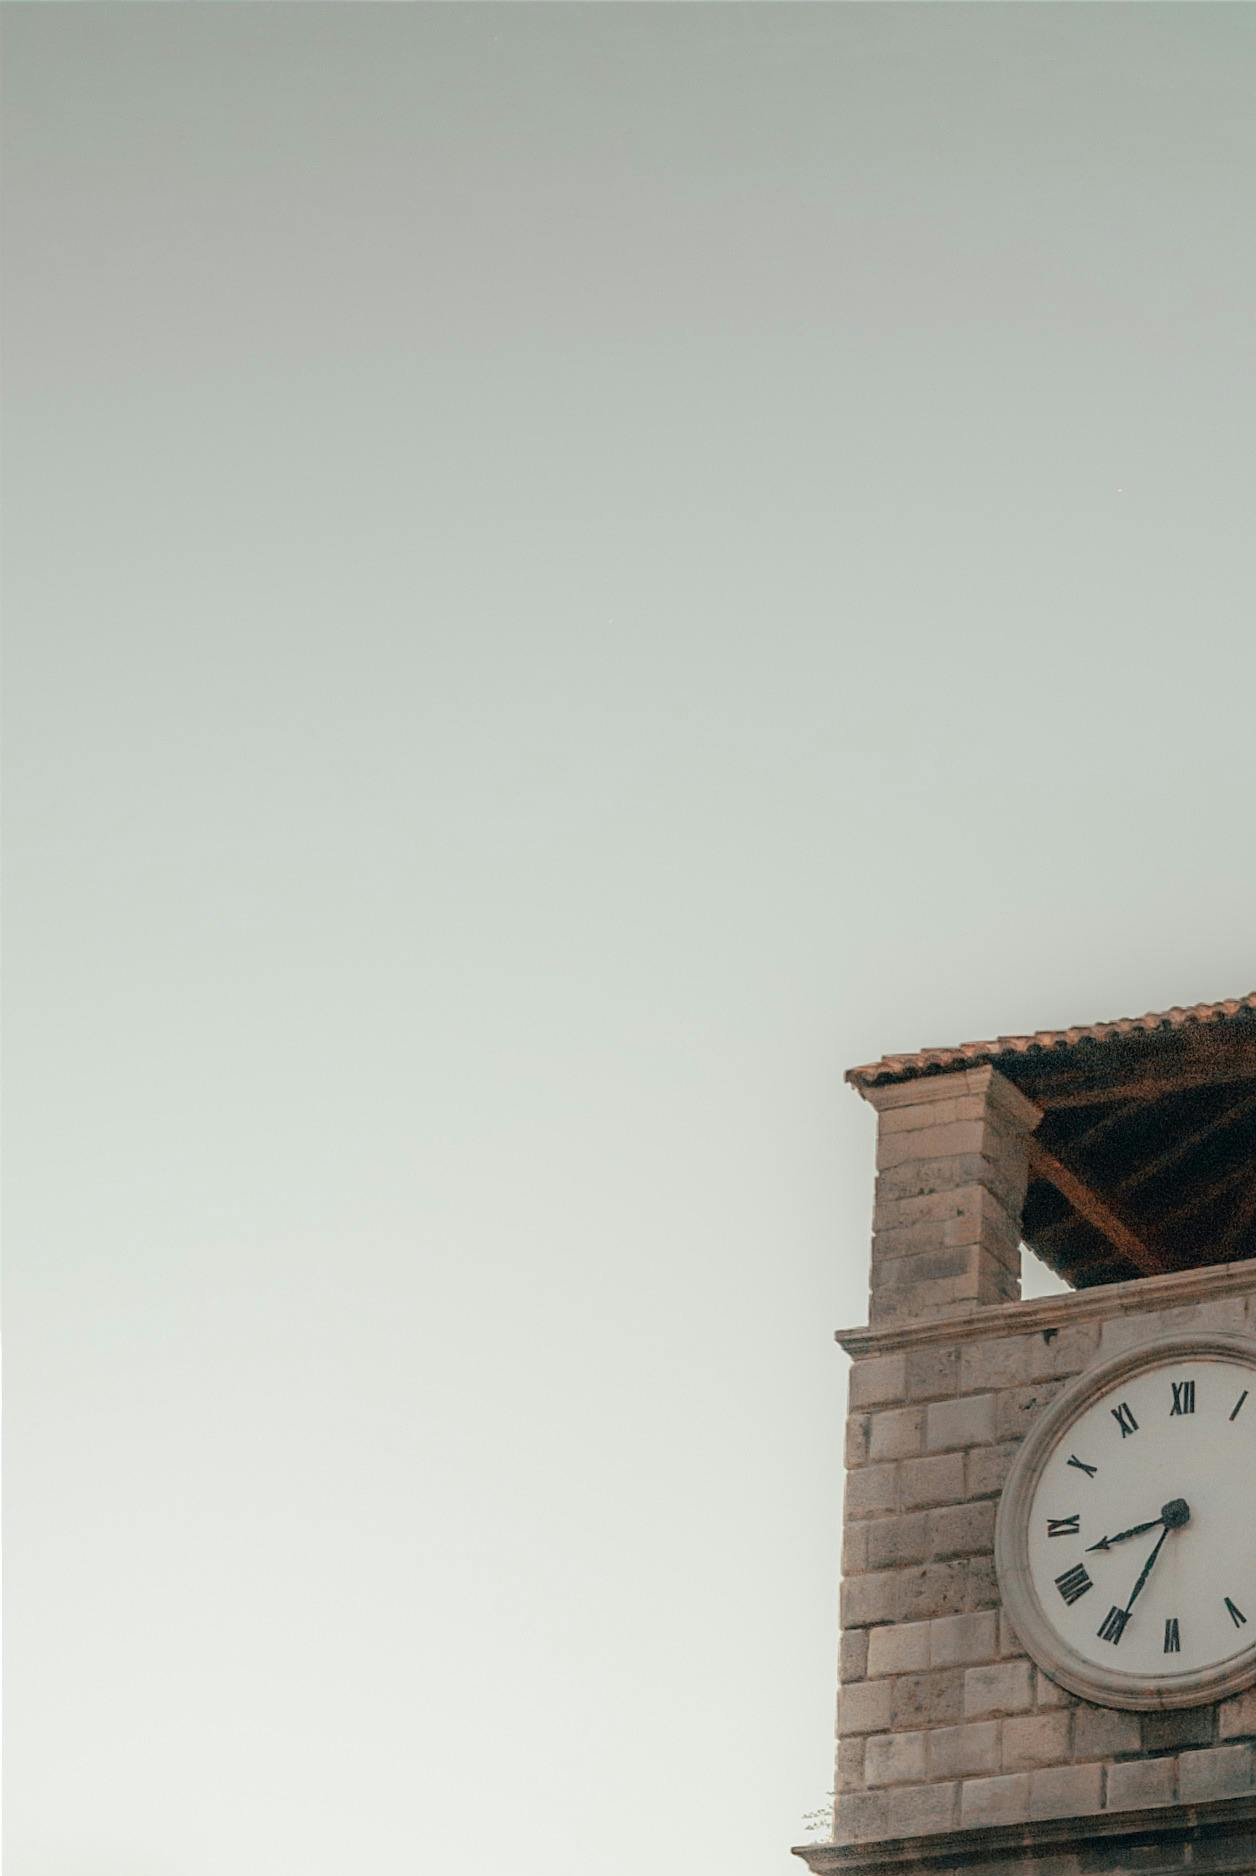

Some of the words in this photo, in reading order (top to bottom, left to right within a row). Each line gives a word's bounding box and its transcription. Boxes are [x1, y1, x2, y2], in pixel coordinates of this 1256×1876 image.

[1170, 1380, 1195, 1416] XII
[1229, 1390, 1248, 1421] I
[1111, 1402, 1139, 1438] XI
[1067, 1454, 1098, 1478] X
[1047, 1515, 1080, 1537] IX
[1224, 1597, 1247, 1628] V
[1164, 1618, 1181, 1653] VI
